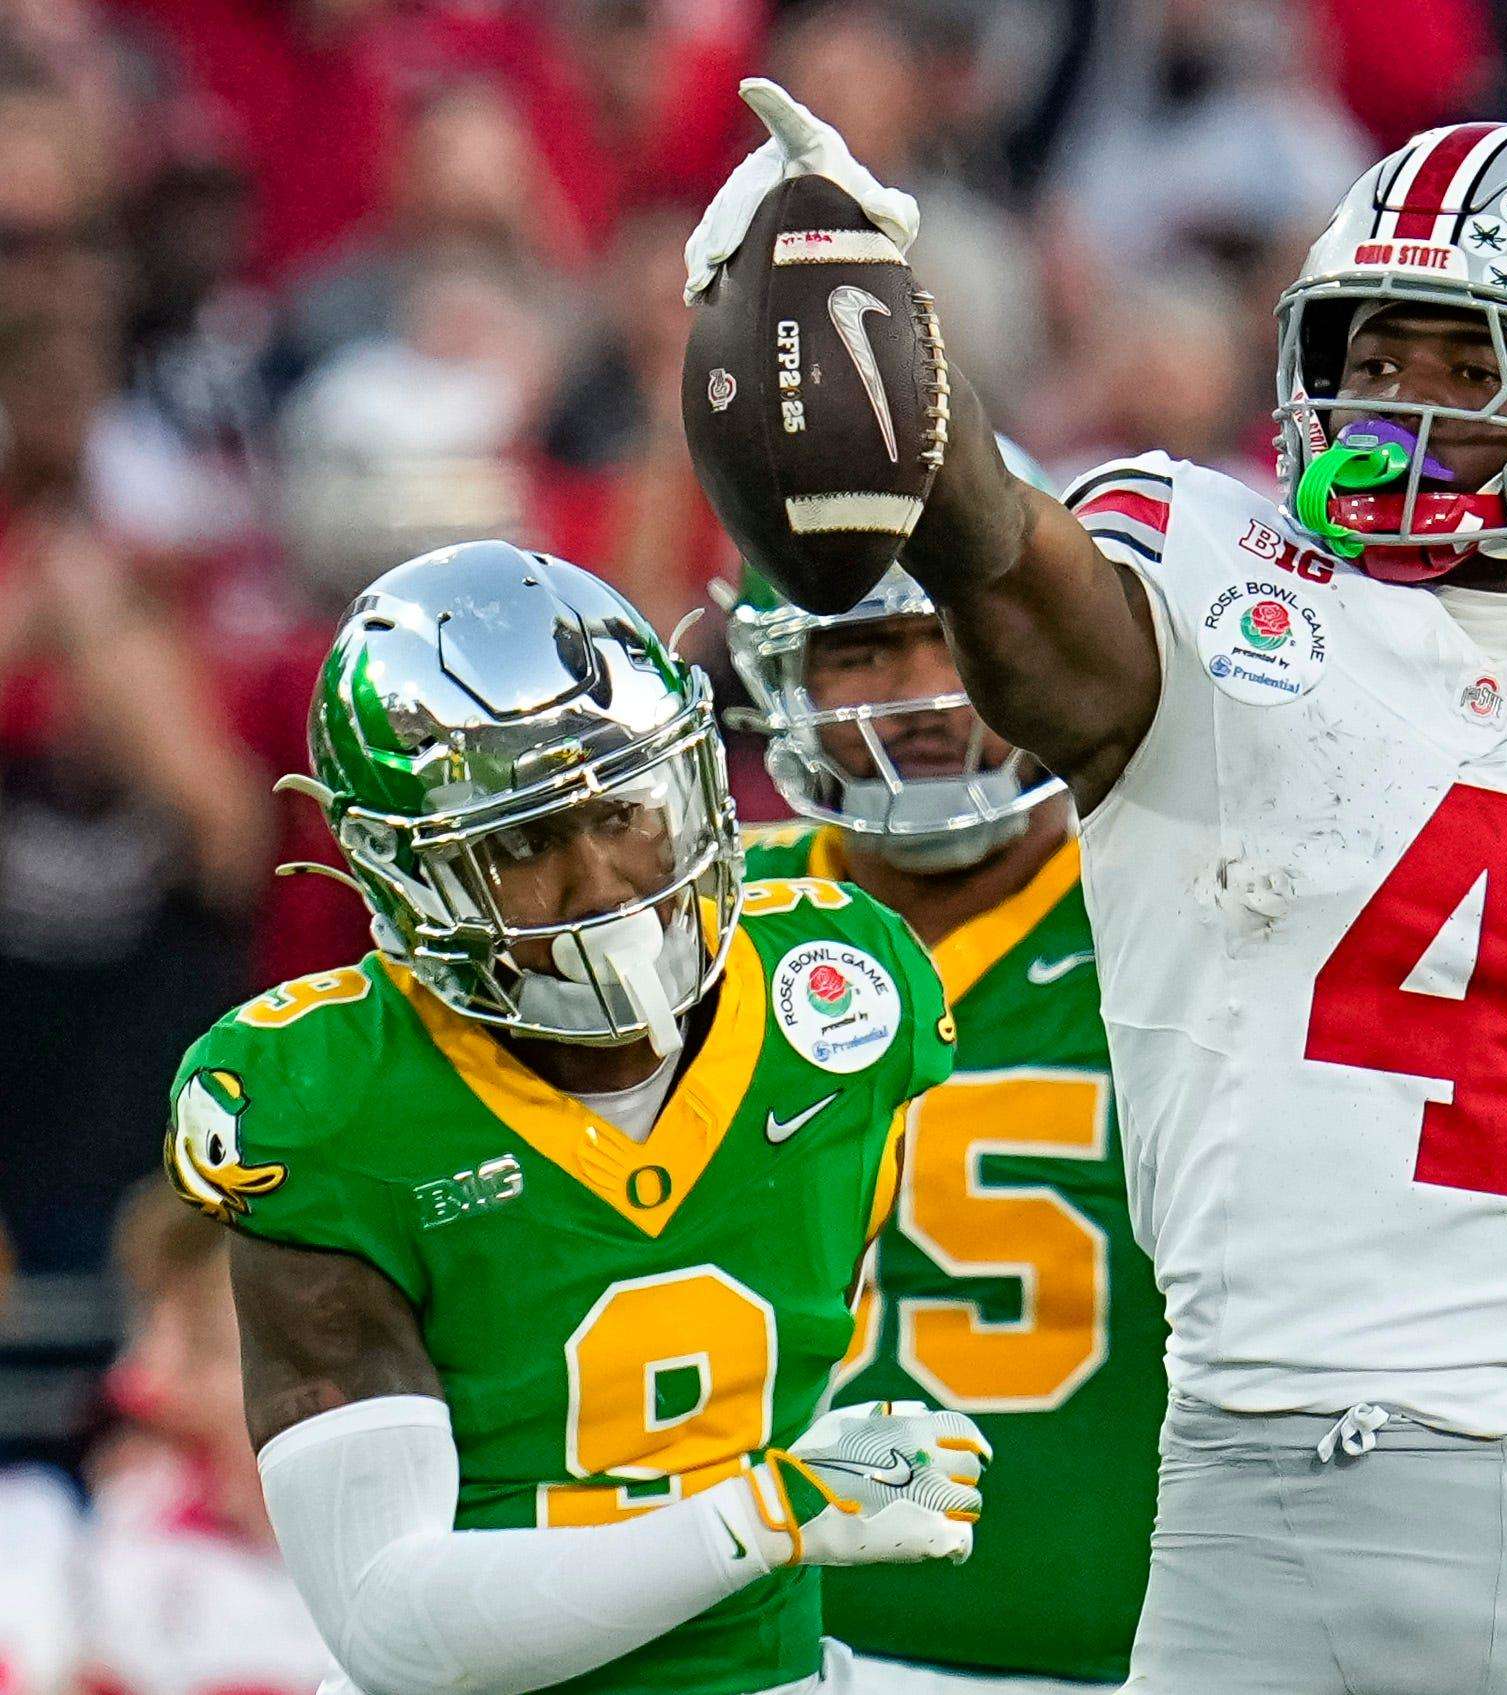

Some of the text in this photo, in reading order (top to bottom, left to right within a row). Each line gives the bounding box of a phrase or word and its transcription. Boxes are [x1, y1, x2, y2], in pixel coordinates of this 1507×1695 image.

[1398, 245, 1452, 269] STATE
[1205, 581, 1326, 663] ROSE BOWL GAME
[1233, 665, 1301, 694] Prudential
[780, 948, 888, 1027] ROSE BOWL GAME
[830, 1066, 1110, 1413] 5
[536, 1263, 778, 1529] 9
